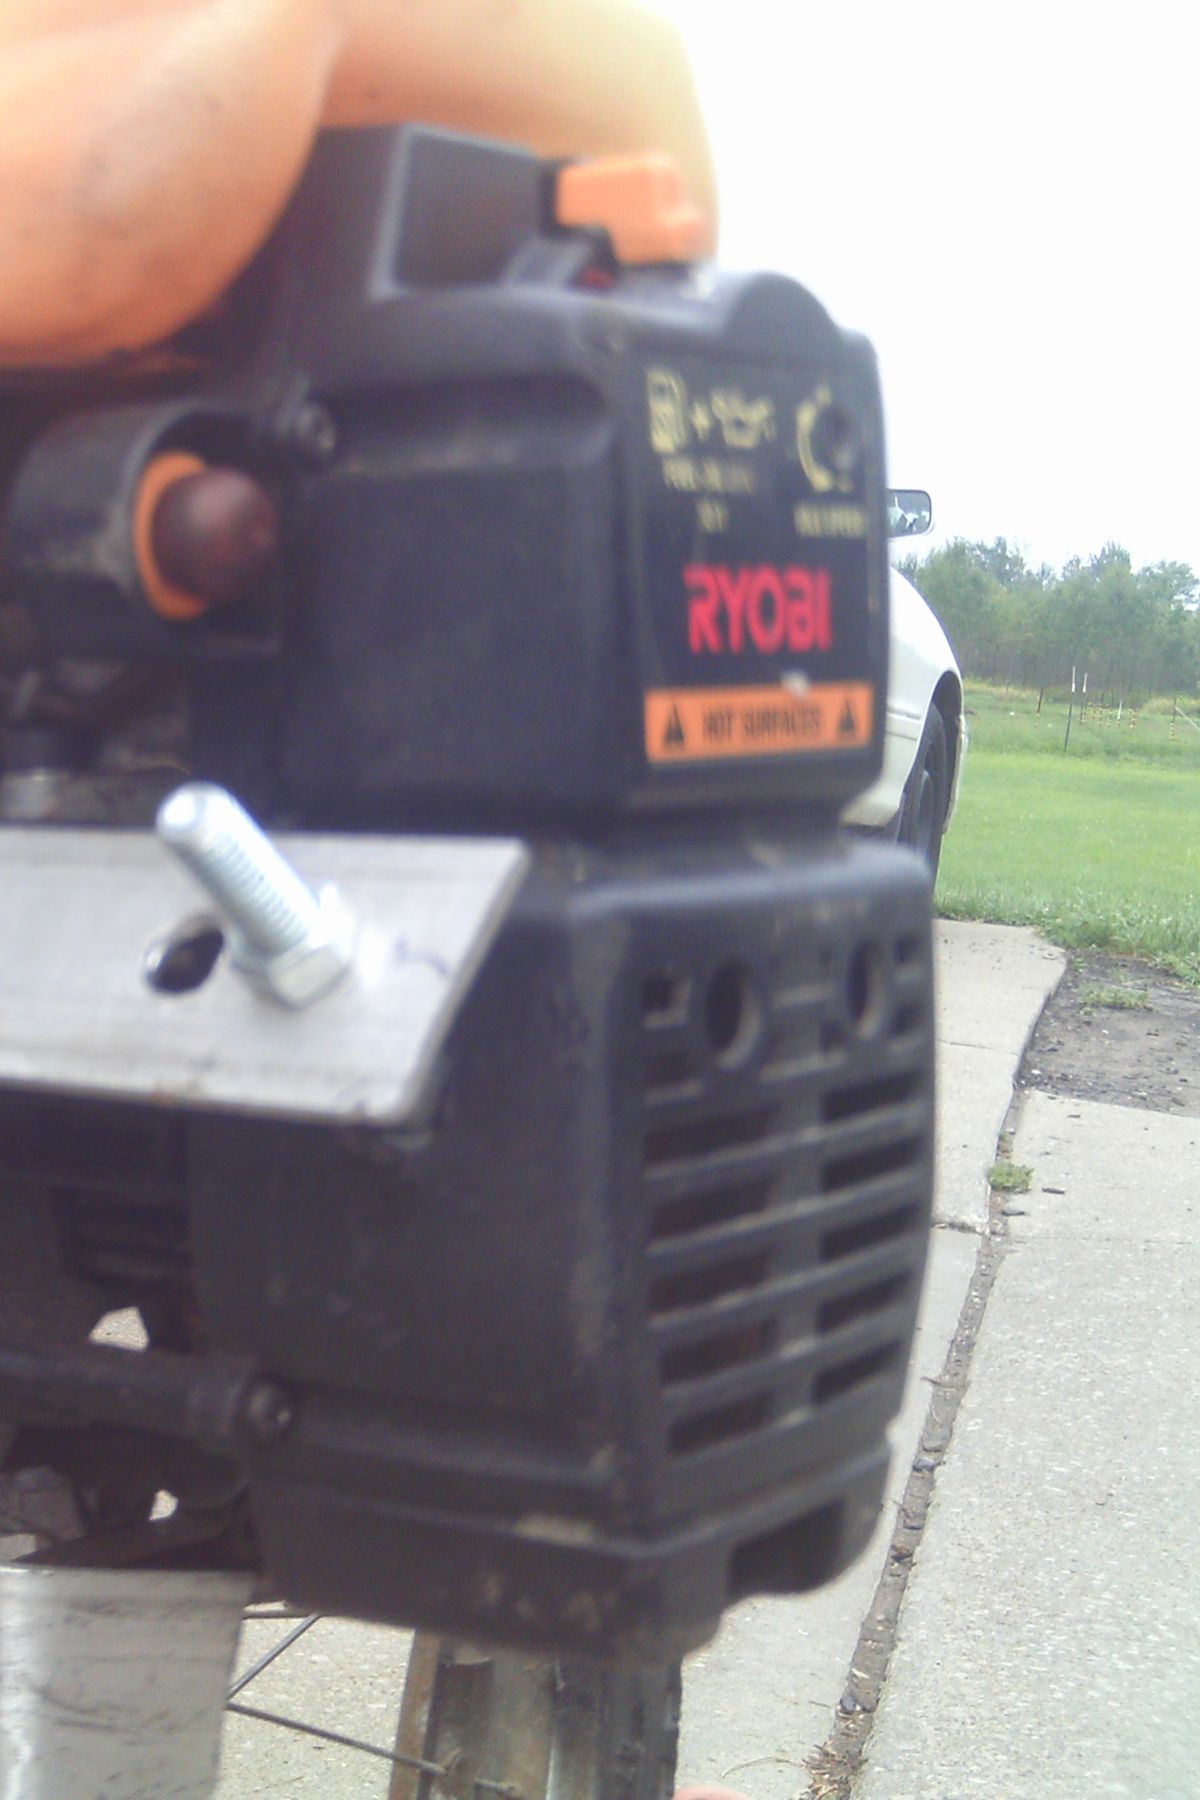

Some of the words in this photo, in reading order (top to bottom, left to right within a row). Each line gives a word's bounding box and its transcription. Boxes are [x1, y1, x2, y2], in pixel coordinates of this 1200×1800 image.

[684, 563, 831, 655] RYOBI
[703, 708, 734, 740] HOT
[744, 703, 822, 737] SURFACES
